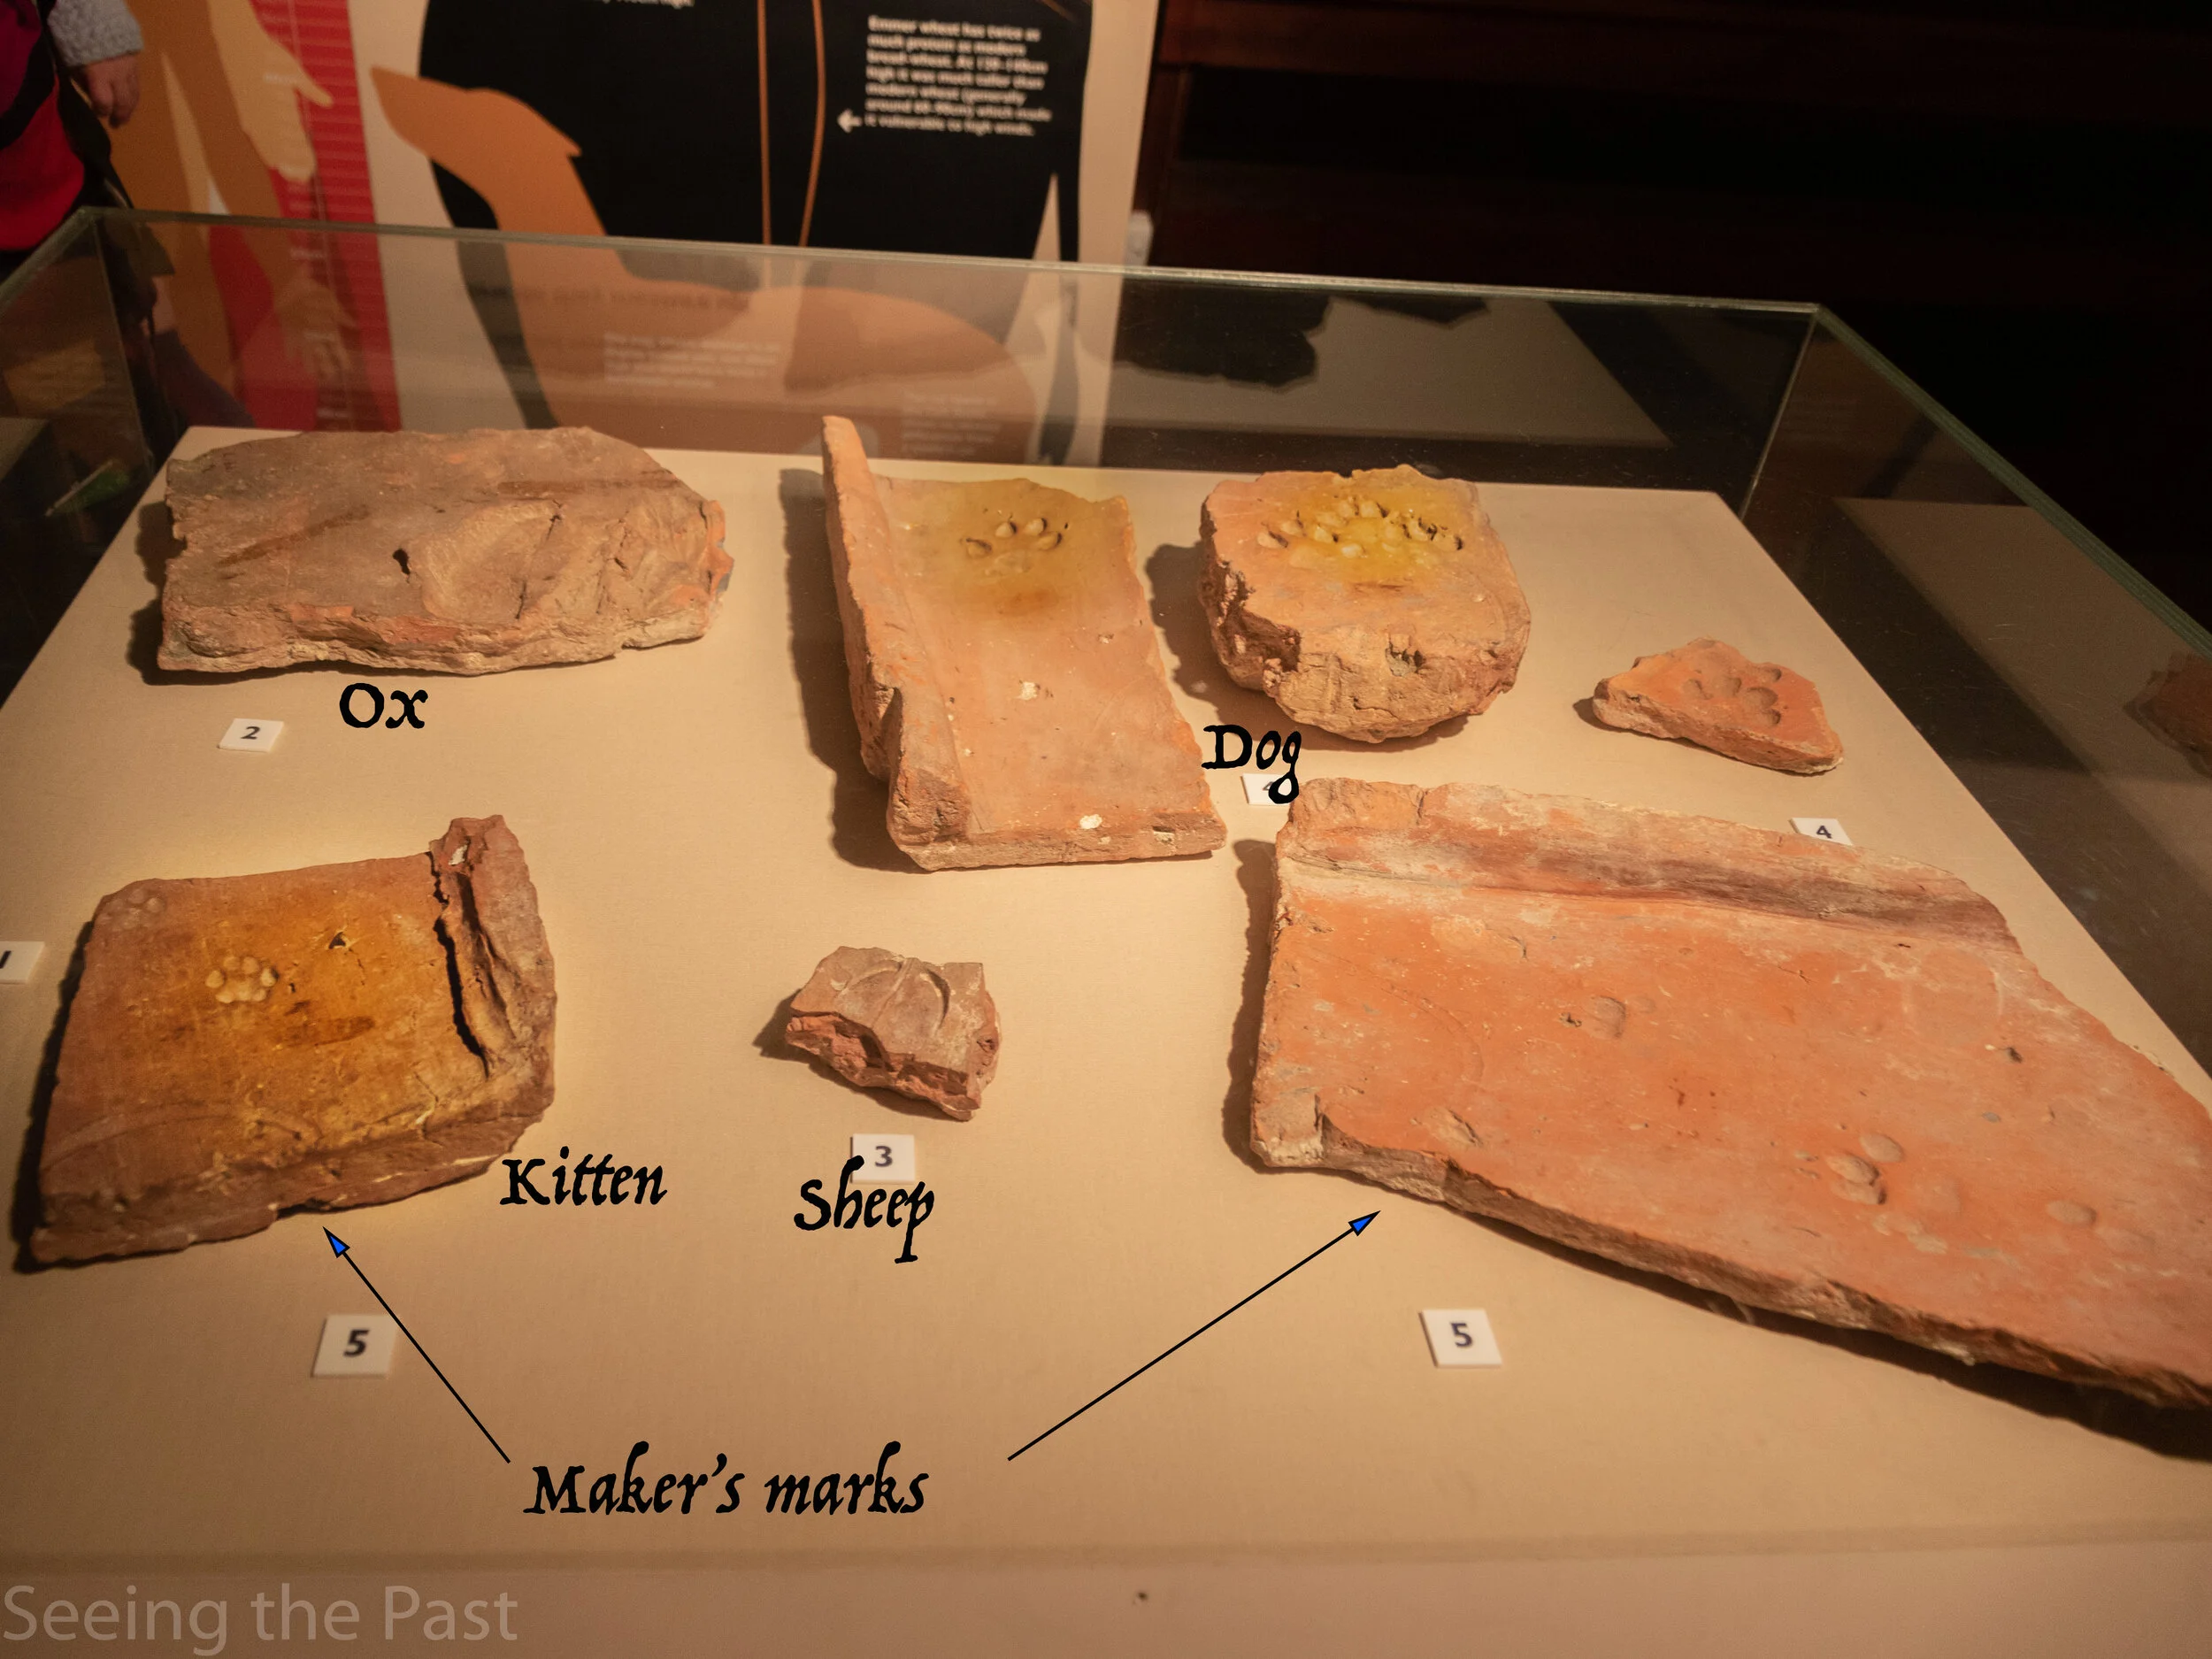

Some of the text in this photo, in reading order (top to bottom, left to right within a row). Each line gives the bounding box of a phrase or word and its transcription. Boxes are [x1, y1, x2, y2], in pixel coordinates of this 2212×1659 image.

[240, 726, 261, 740] 2
[1816, 825, 1832, 839] 4
[873, 1145, 894, 1167] 3
[342, 1328, 370, 1358] 5
[1450, 1322, 1473, 1348] 5
